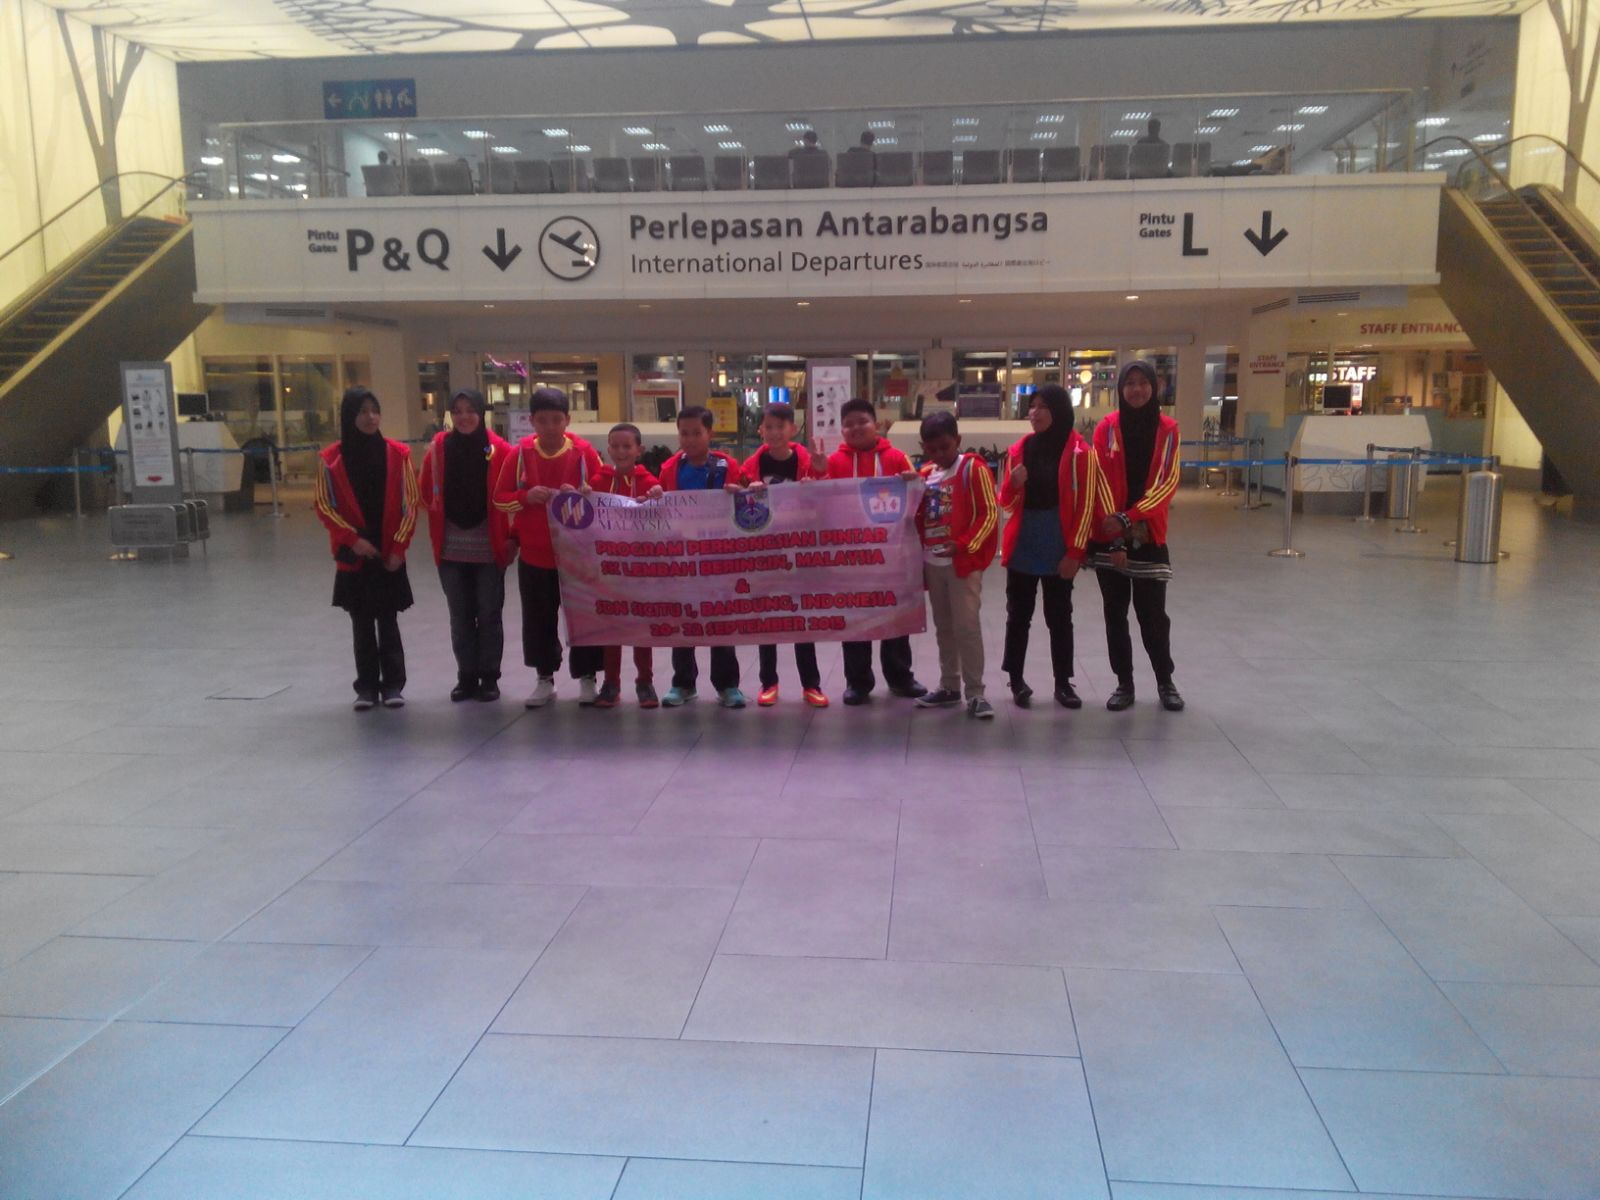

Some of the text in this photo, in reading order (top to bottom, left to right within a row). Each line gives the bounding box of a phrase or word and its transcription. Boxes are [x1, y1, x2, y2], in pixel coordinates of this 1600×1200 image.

[629, 207, 1049, 245] Perlepasan Antarabangsa
[1138, 212, 1176, 226] Pintu
[307, 228, 340, 242] Pintu
[1138, 227, 1172, 239] Gates
[1182, 212, 1209, 256] L
[308, 243, 338, 255] Gates
[630, 251, 783, 274] International
[790, 250, 924, 277] Departures
[1360, 321, 1463, 335] STAFF ENTRANC
[597, 507, 683, 521] PENDIDIKAN
[598, 519, 672, 532] MALAYSIA
[595, 541, 685, 557] PROGRAM
[687, 532, 817, 554] PERKONGSIAN
[819, 527, 888, 546] PINTAR
[623, 560, 697, 577] LEMBAH
[699, 554, 792, 576] BERINGIN,
[795, 548, 885, 568] MALAYSIA
[700, 595, 798, 617] BANDUNG,
[801, 591, 897, 610] INDONESIA
[705, 616, 806, 637] SEPTEMBER
